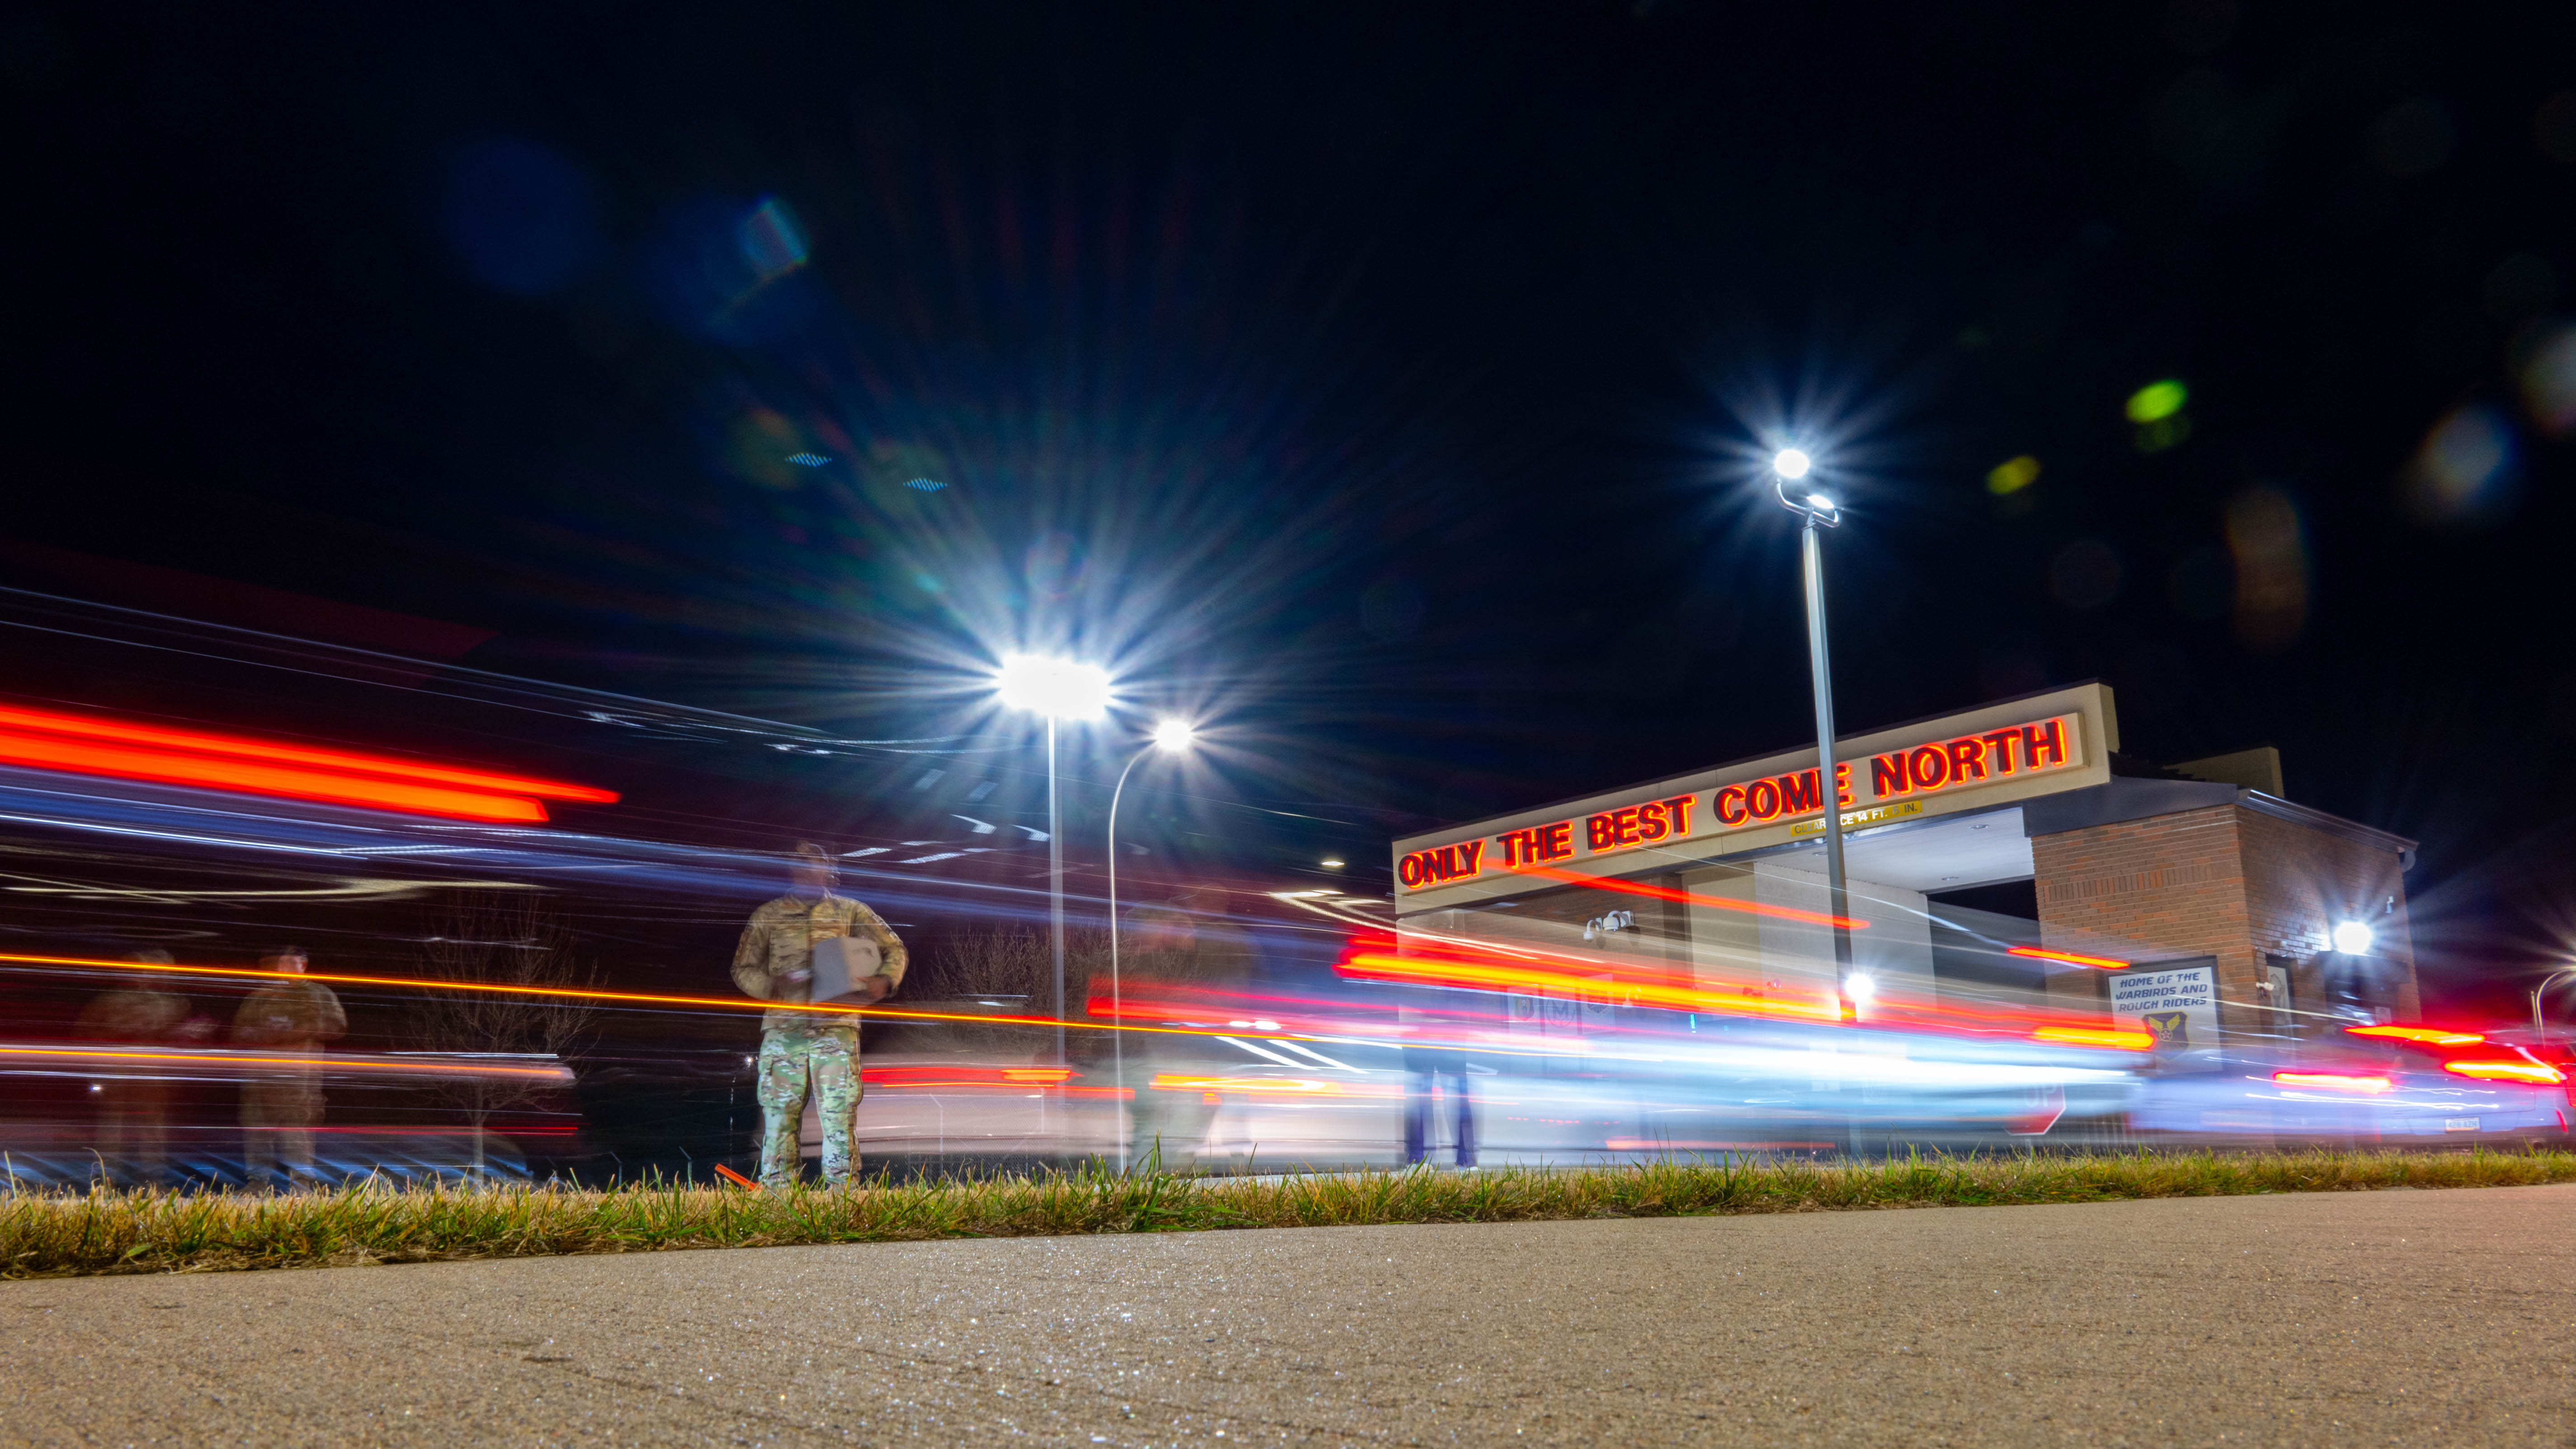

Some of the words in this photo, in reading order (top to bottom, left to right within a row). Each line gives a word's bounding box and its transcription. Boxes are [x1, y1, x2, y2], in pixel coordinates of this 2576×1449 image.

[1398, 841, 1484, 888] ONLY
[1496, 822, 1574, 869] THE
[1586, 796, 1696, 854] BEST
[1870, 719, 2065, 798] NORTH
[1794, 815, 1853, 834] CLEARCE
[1856, 811, 1867, 822] 14
[1872, 809, 1887, 820] FT.
[1892, 806, 1900, 814] 6
[1904, 803, 1917, 813] IN.
[2120, 977, 2154, 988] HOME
[2157, 975, 2172, 984] OF
[2176, 972, 2200, 982] THE
[2116, 987, 2177, 1000] WARBIRDS
[2181, 984, 2208, 994] AND
[2119, 1000, 2158, 1012] ROUGH
[2162, 996, 2207, 1008] RIDERS
